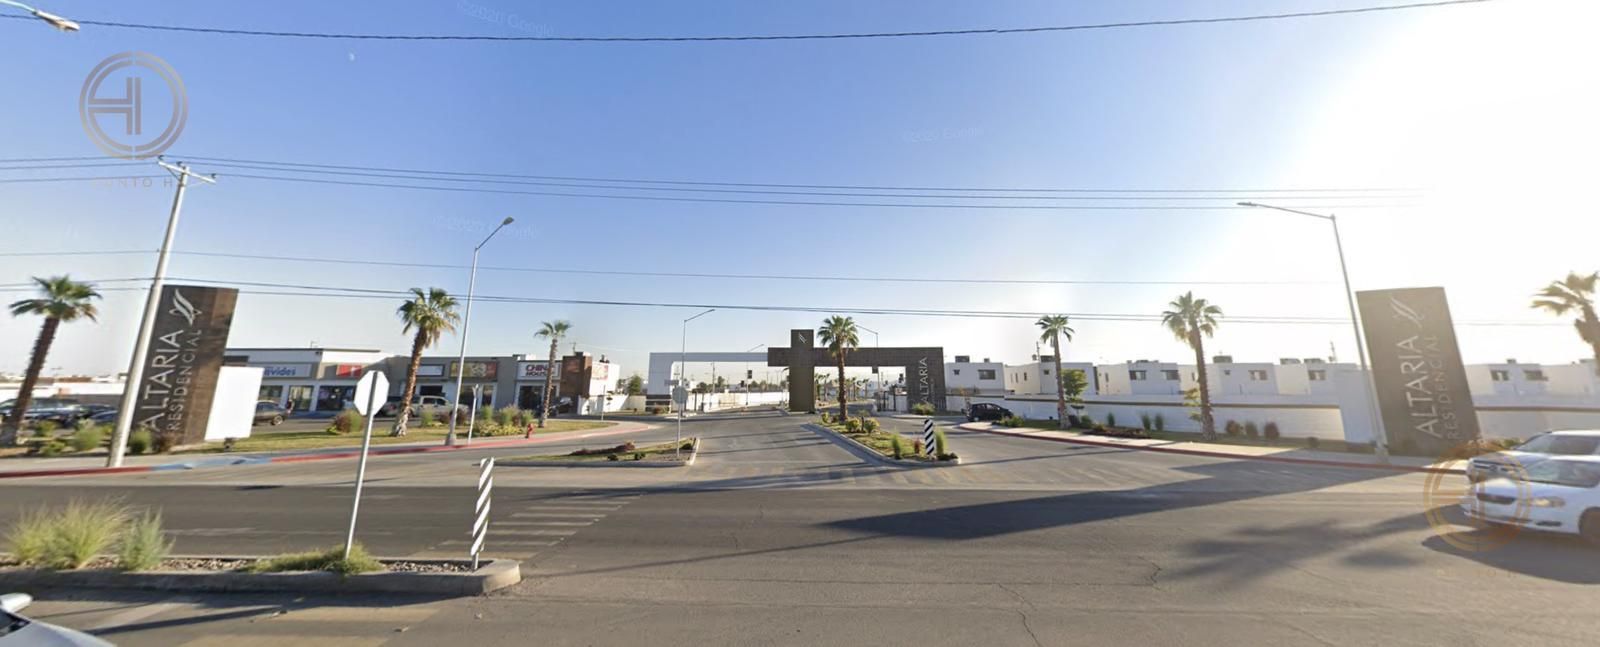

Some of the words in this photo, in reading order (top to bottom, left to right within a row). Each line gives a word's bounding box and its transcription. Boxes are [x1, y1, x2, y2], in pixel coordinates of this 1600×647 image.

[137, 329, 184, 432] ALTARIA
[166, 329, 202, 431] RESIDENCIAL
[919, 357, 930, 404] ALTARIA
[1396, 335, 1443, 439] ALTARIA
[1424, 335, 1460, 440] RESIDENCIAL
